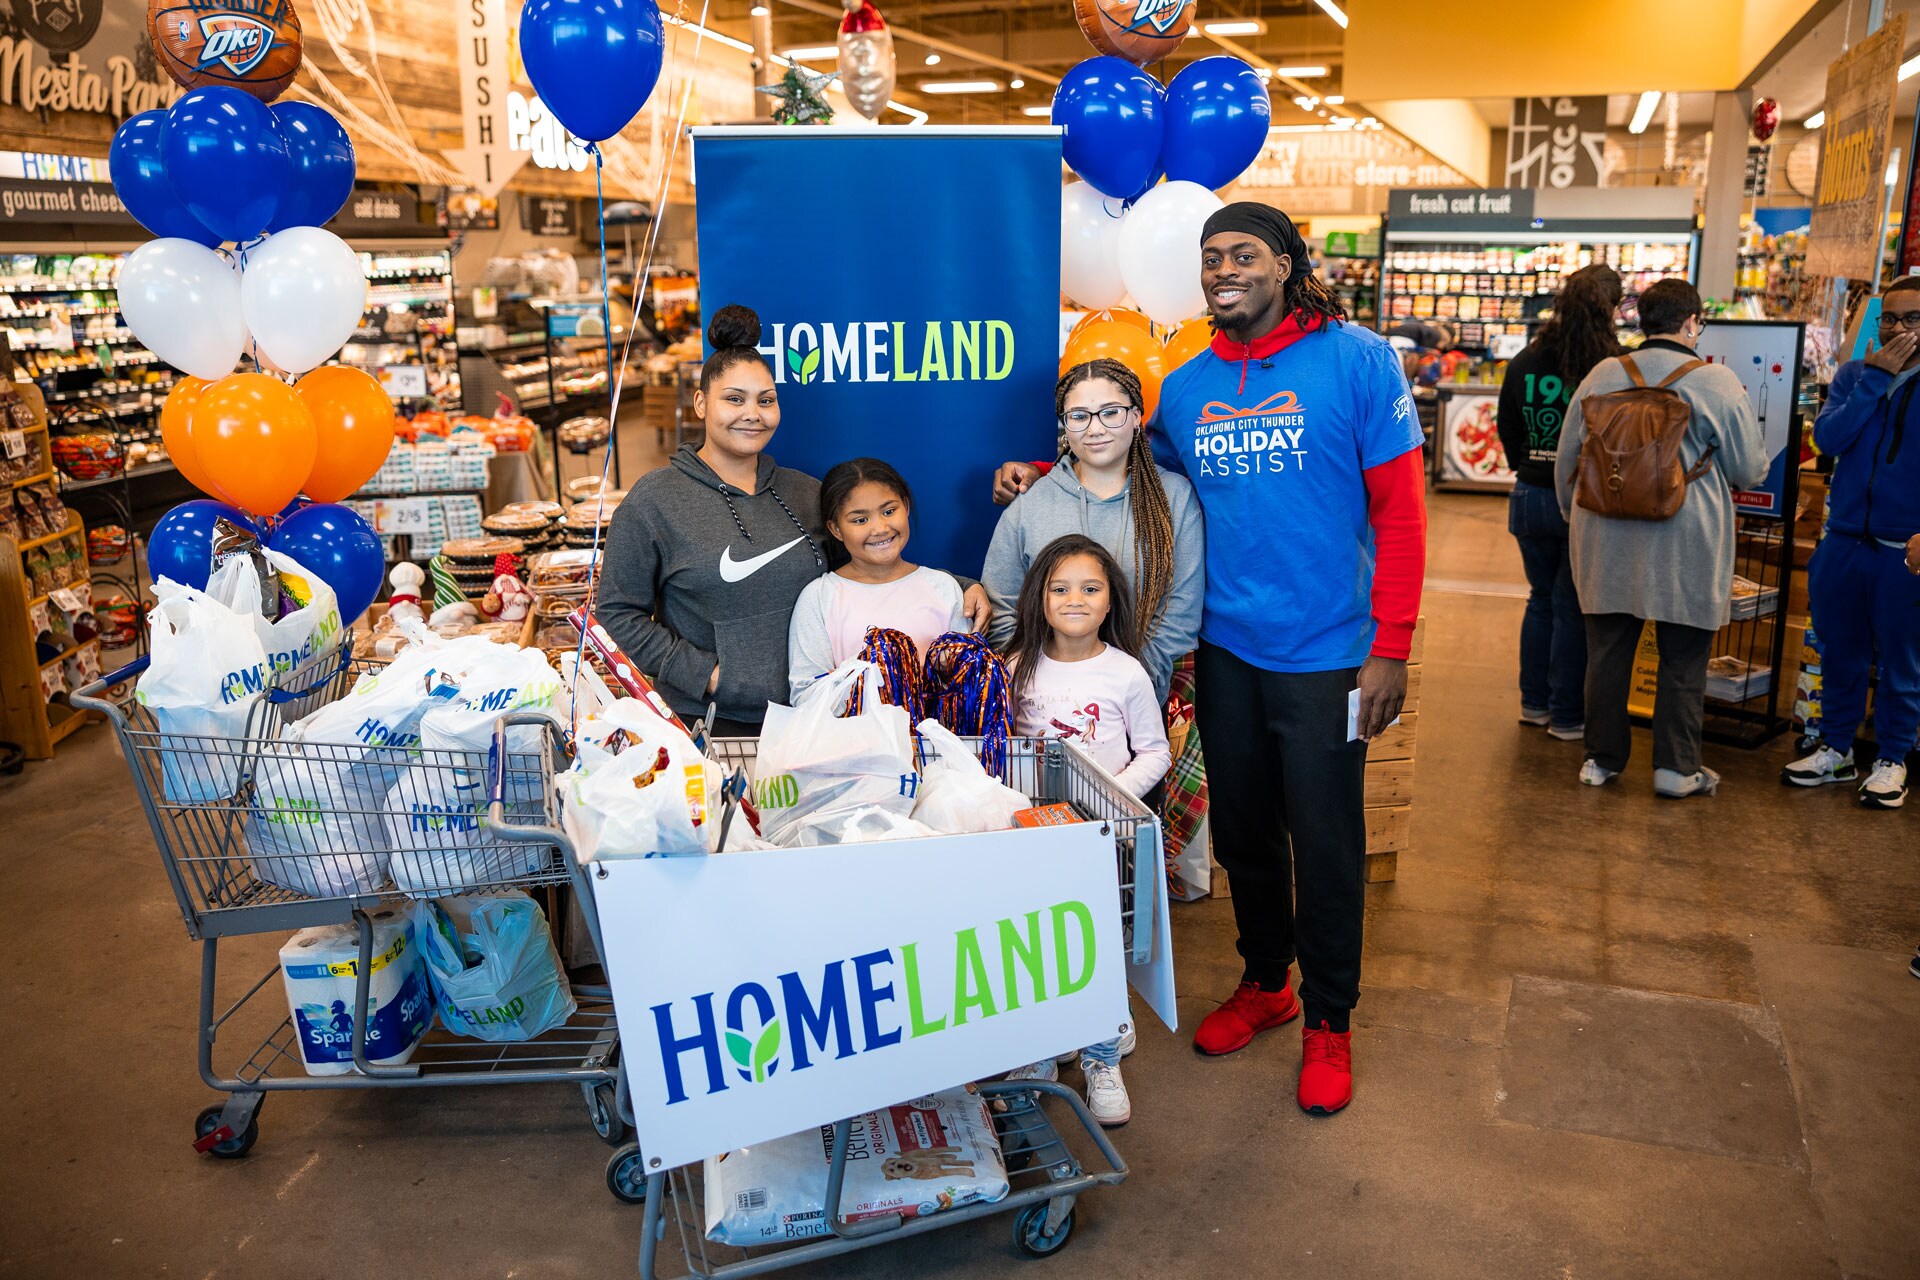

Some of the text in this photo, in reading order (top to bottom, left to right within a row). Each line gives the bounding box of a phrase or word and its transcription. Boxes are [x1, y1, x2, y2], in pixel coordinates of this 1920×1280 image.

[200, 28, 260, 61] OKC
[0, 36, 108, 113] Nesta
[472, 0, 493, 183] SUSHI
[1819, 109, 1874, 206] blooms
[2, 187, 77, 218] gourmet
[1409, 192, 1512, 214] fresh cut fruit
[757, 319, 1015, 385] HOMELAND
[1195, 415, 1304, 437] OKLAHOMA CITY THUNDER
[1194, 428, 1305, 458] HOLIDAY
[1200, 451, 1308, 478] ASSIST
[649, 899, 1098, 1106] HOMELAND
[311, 1028, 381, 1048] Sparle
[866, 1112, 886, 1155] ORIGINALS
[856, 1197, 904, 1211] ORIGINALS
